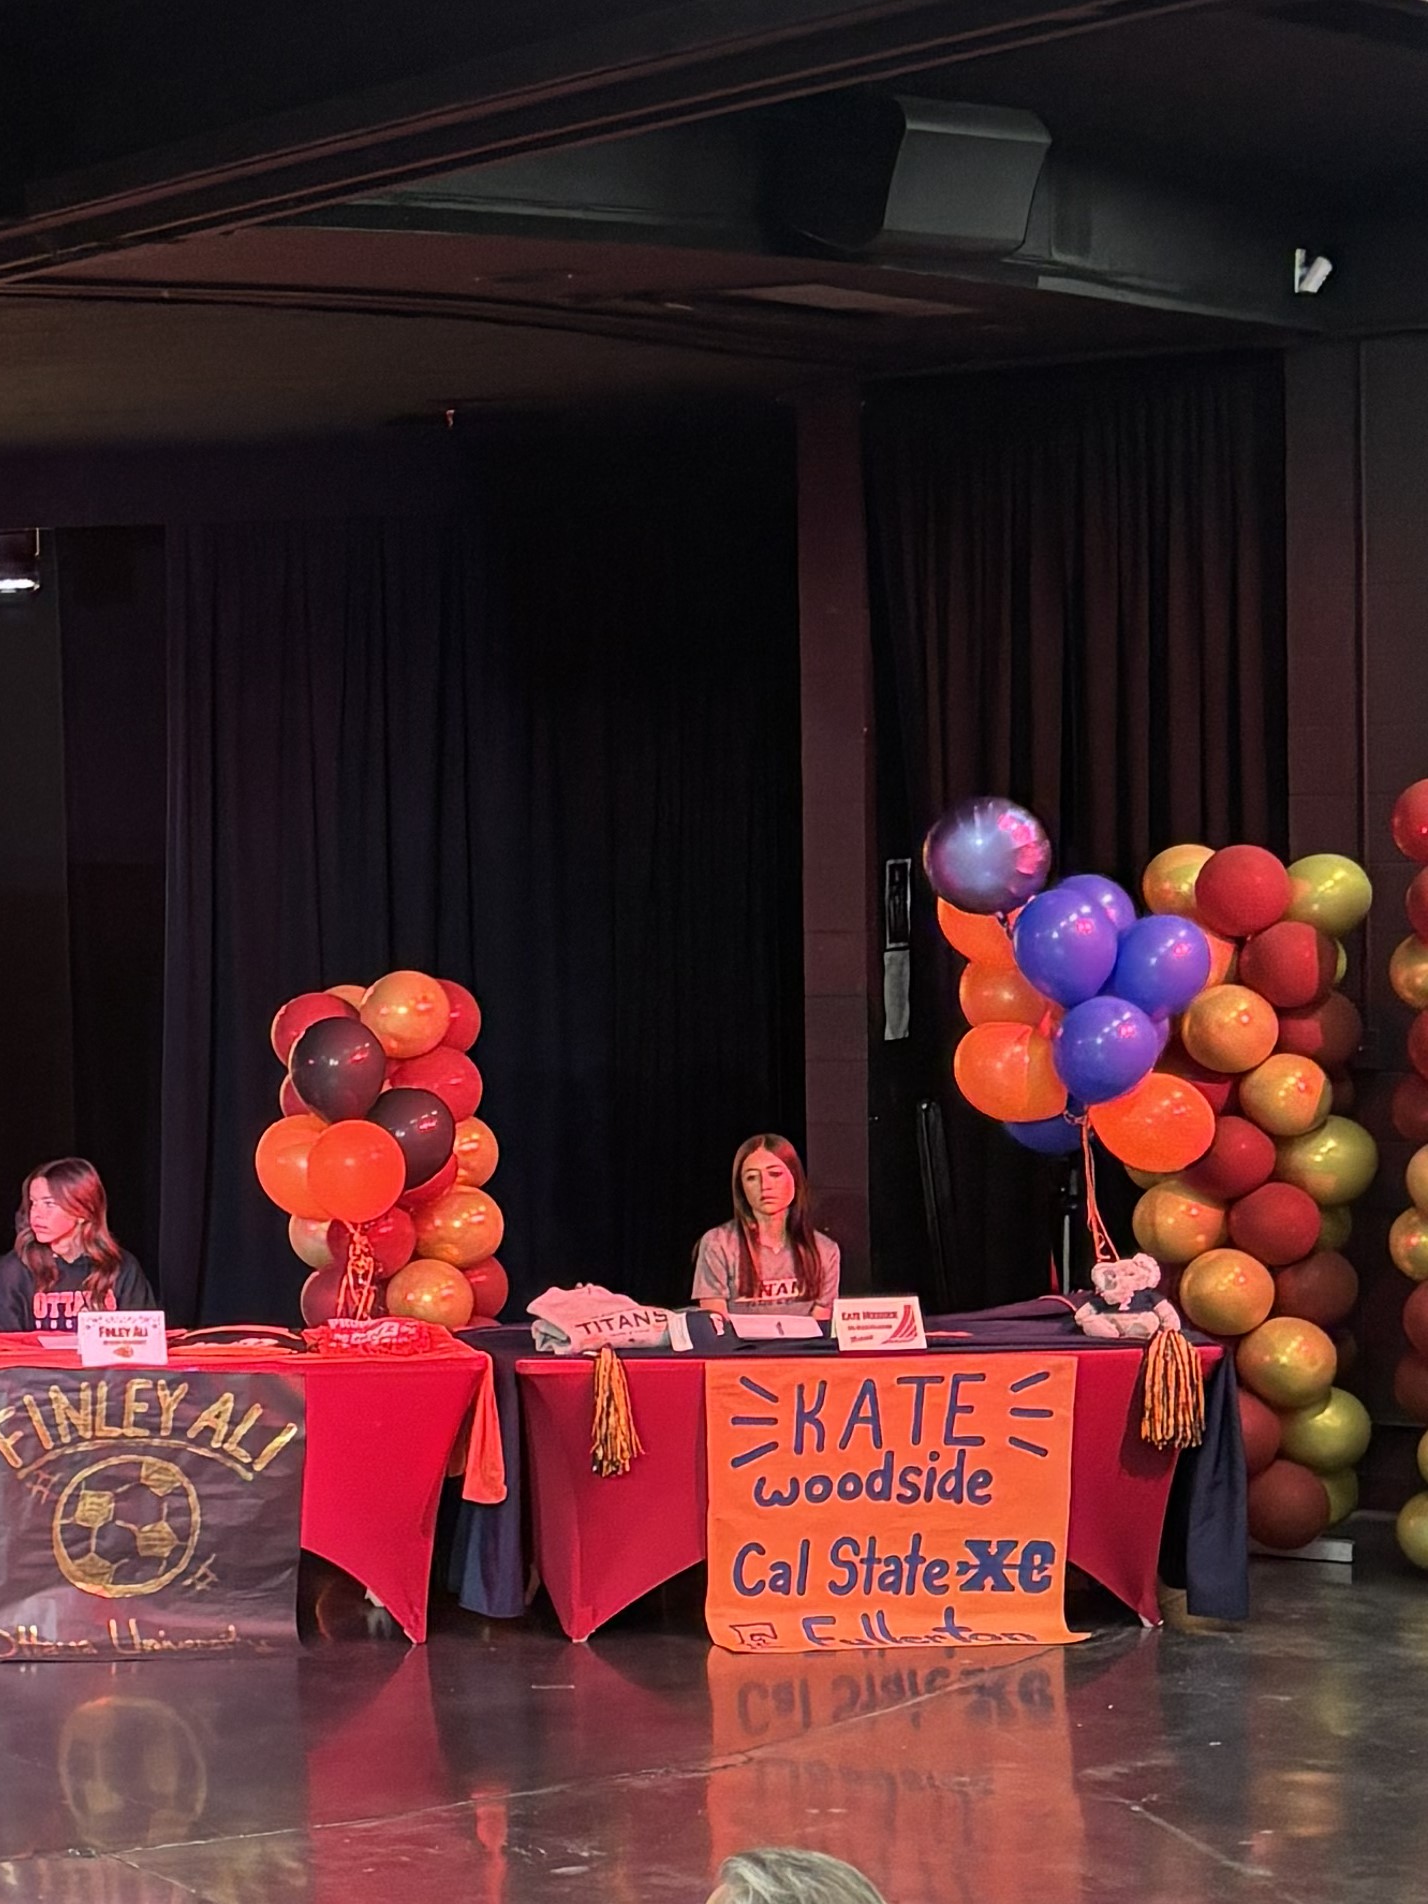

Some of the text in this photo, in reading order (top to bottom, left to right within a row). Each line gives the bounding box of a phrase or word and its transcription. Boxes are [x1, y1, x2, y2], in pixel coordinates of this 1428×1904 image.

[34, 1289, 117, 1319] OTTA
[575, 1310, 668, 1335] TITANS
[187, 1392, 297, 1471] ALI
[794, 1373, 986, 1455] KATE
[732, 1540, 809, 1597] Cal
[829, 1533, 948, 1596] State
